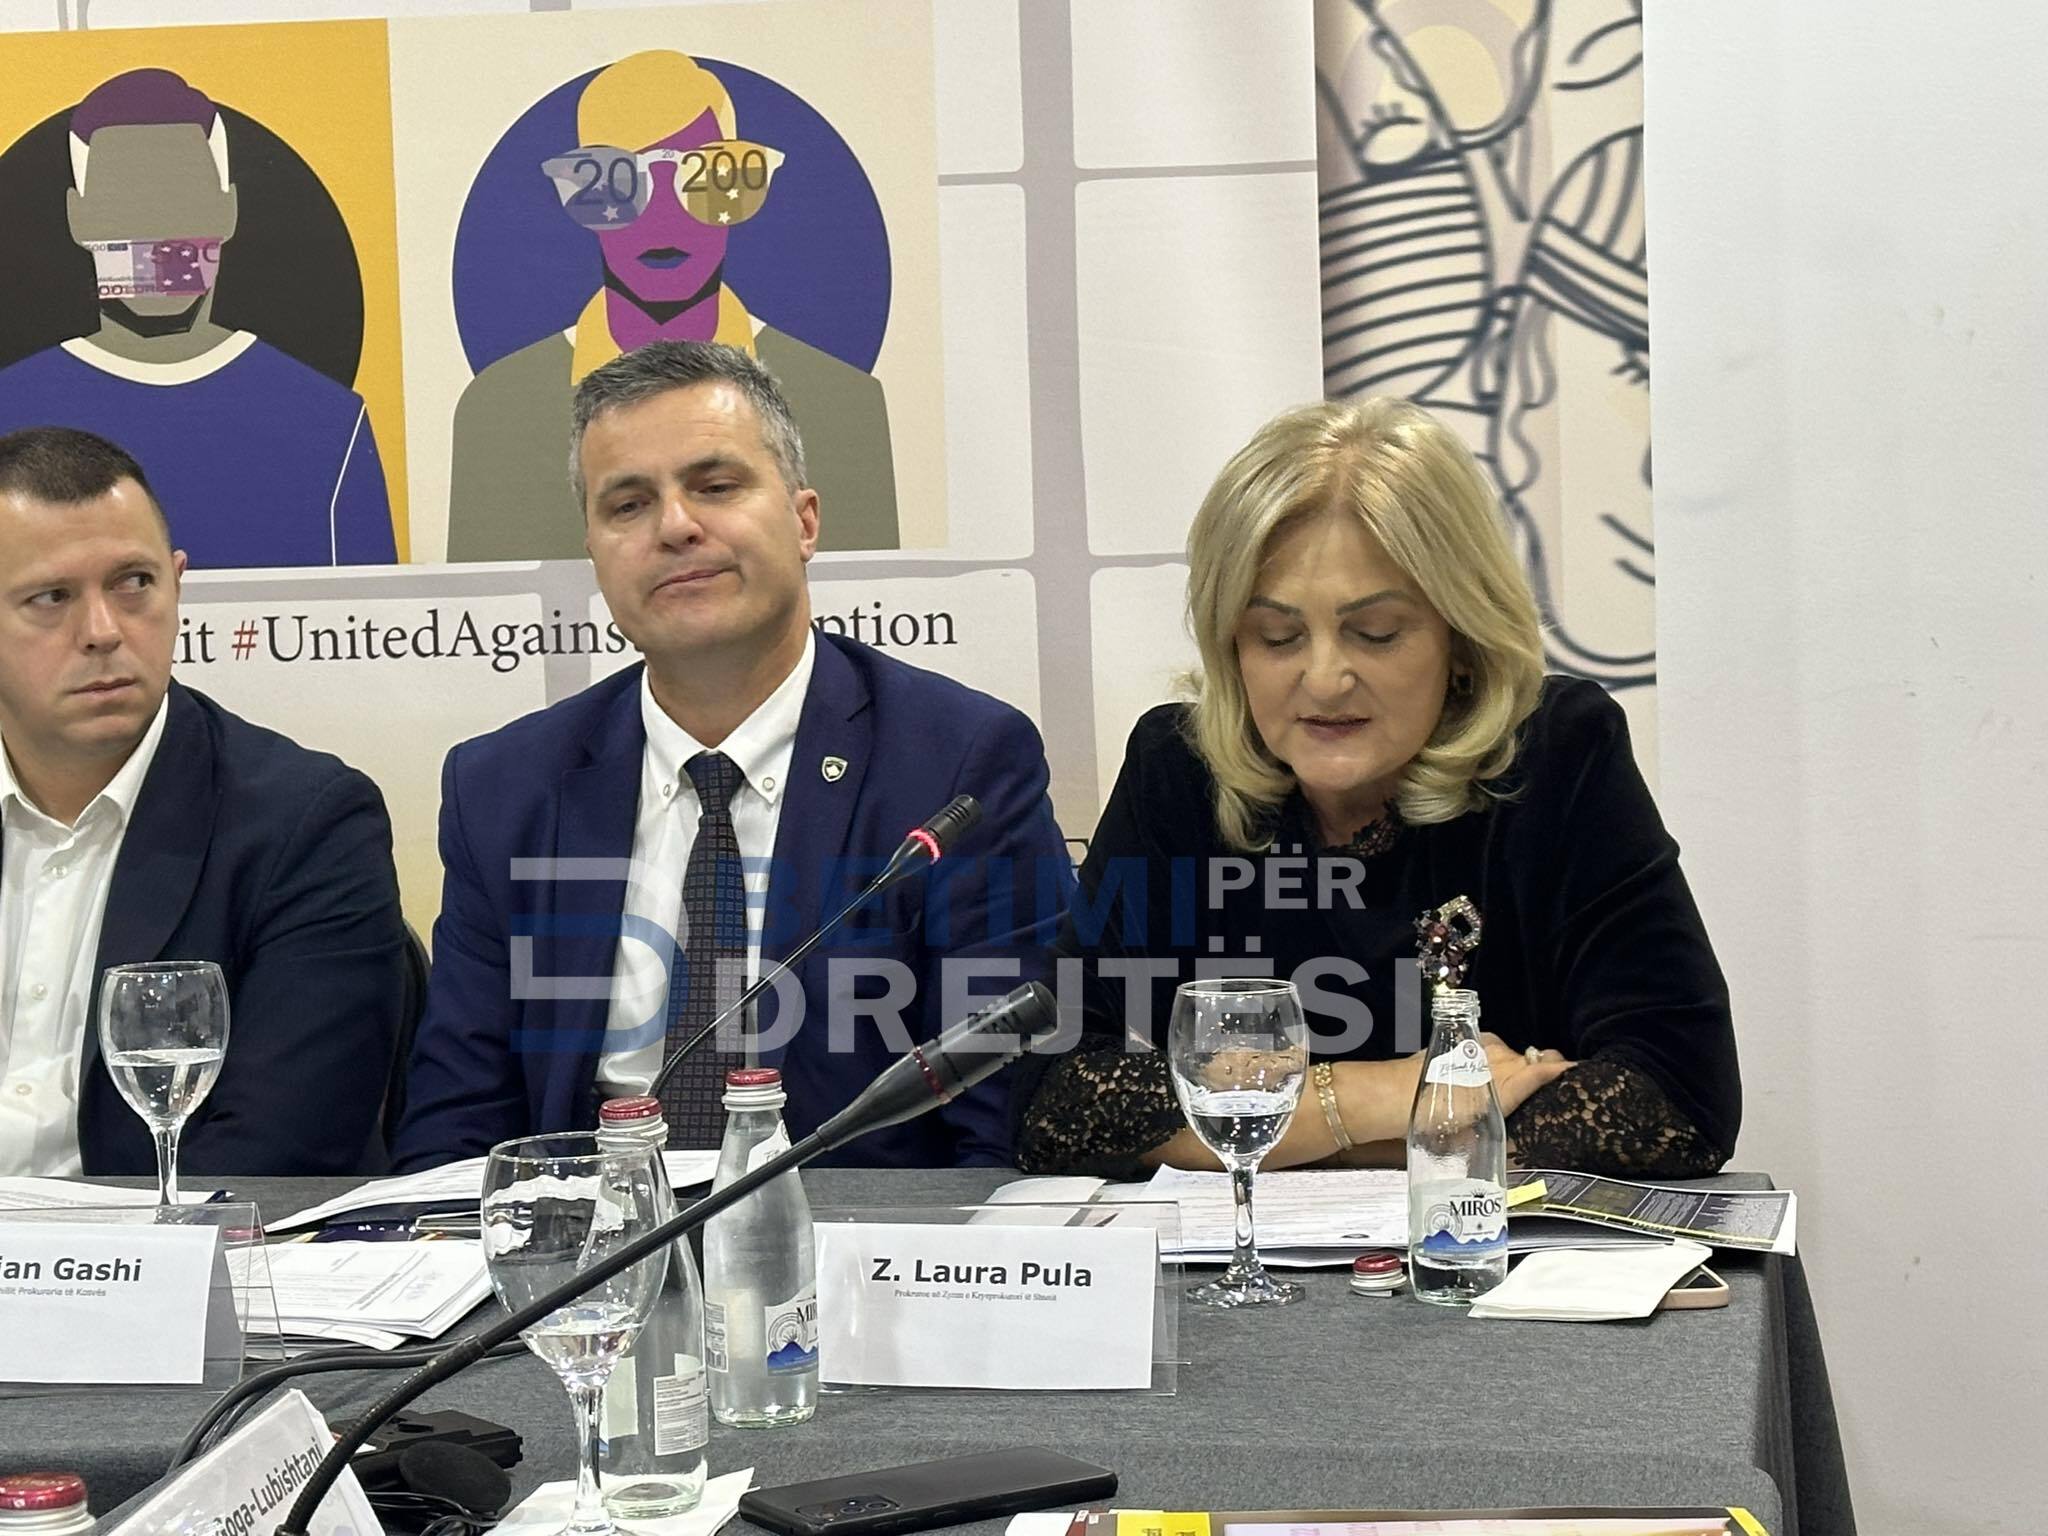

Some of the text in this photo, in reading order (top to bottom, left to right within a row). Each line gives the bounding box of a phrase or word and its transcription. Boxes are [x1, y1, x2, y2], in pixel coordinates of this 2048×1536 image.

[572, 148, 768, 205] 20 200
[172, 617, 216, 663] it
[231, 609, 627, 673] #UnitedAgains
[1449, 1197, 1503, 1218] MIROS
[53, 1257, 142, 1282] Gashi
[871, 1258, 1093, 1287] Z. Laura Pula
